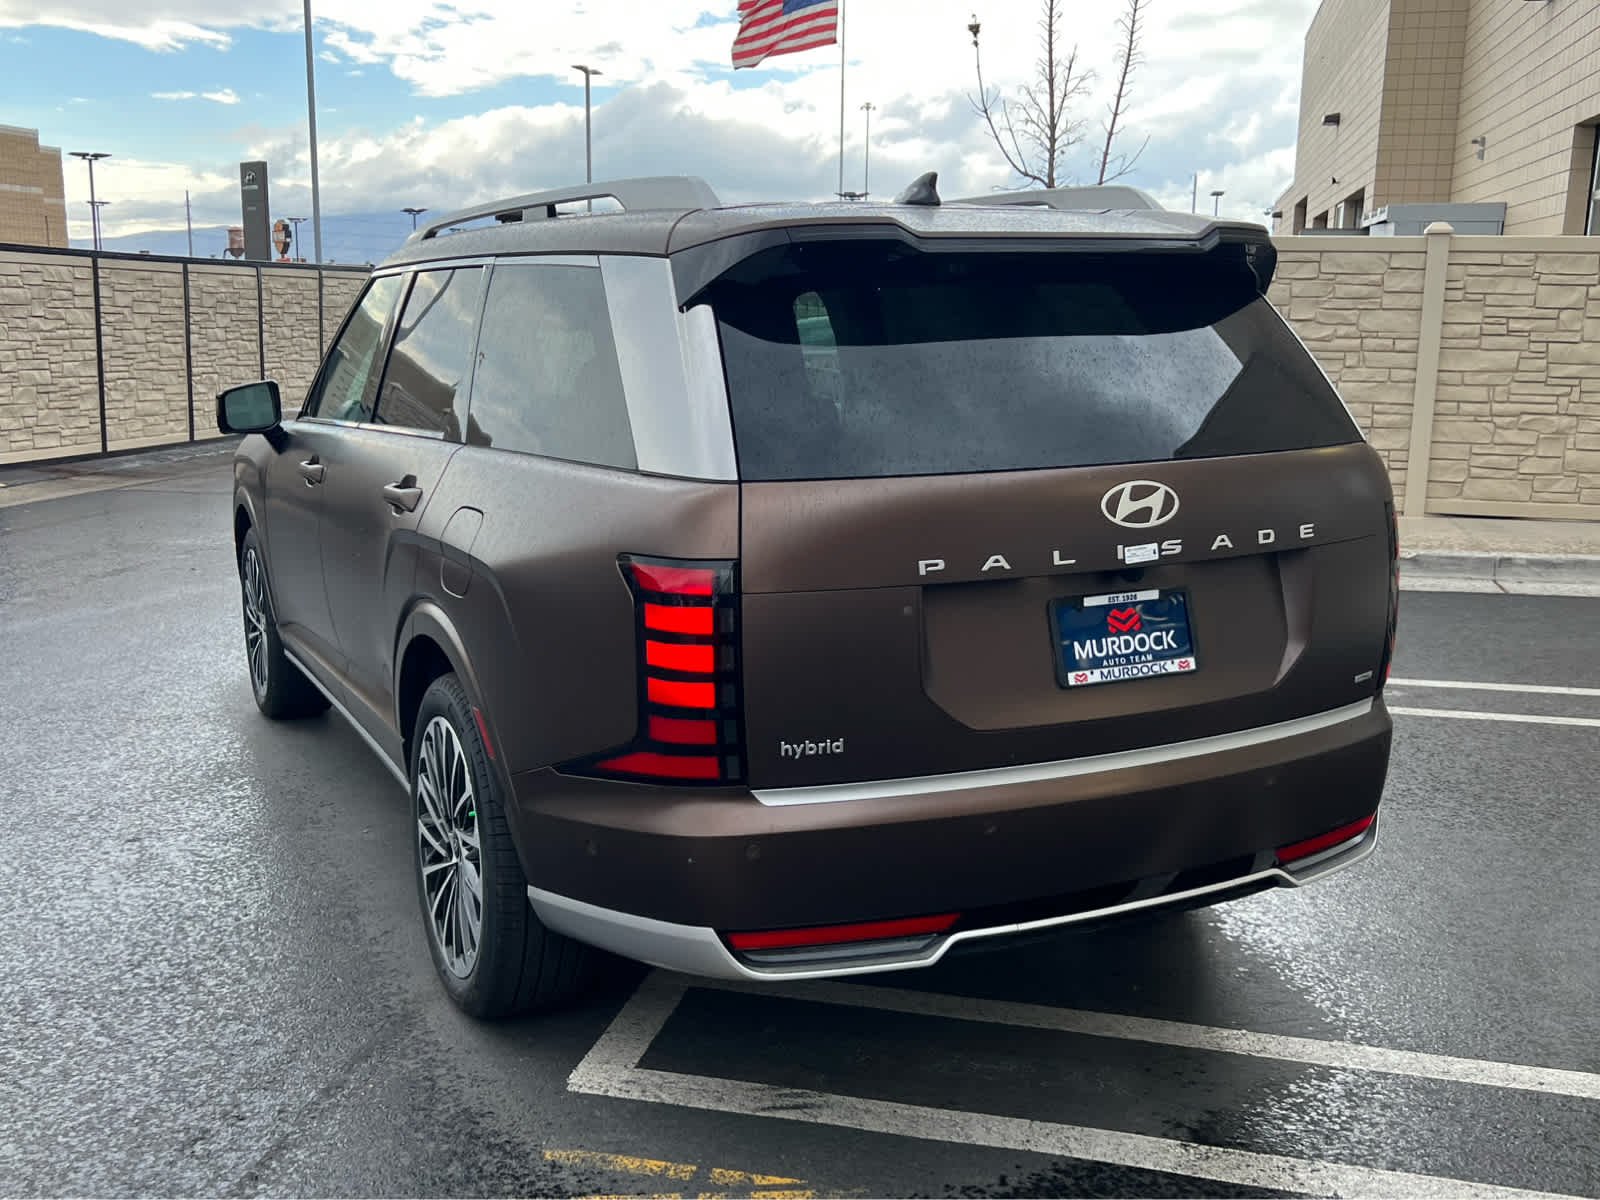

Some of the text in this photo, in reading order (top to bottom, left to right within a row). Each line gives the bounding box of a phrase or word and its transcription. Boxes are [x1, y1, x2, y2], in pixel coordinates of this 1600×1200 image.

[918, 523, 1315, 577] PALISADE
[1073, 629, 1177, 660] MURDOCK
[1100, 661, 1168, 681] MURDOCK
[1102, 654, 1153, 667] AUTO TEAM
[780, 738, 844, 759] hybrid
